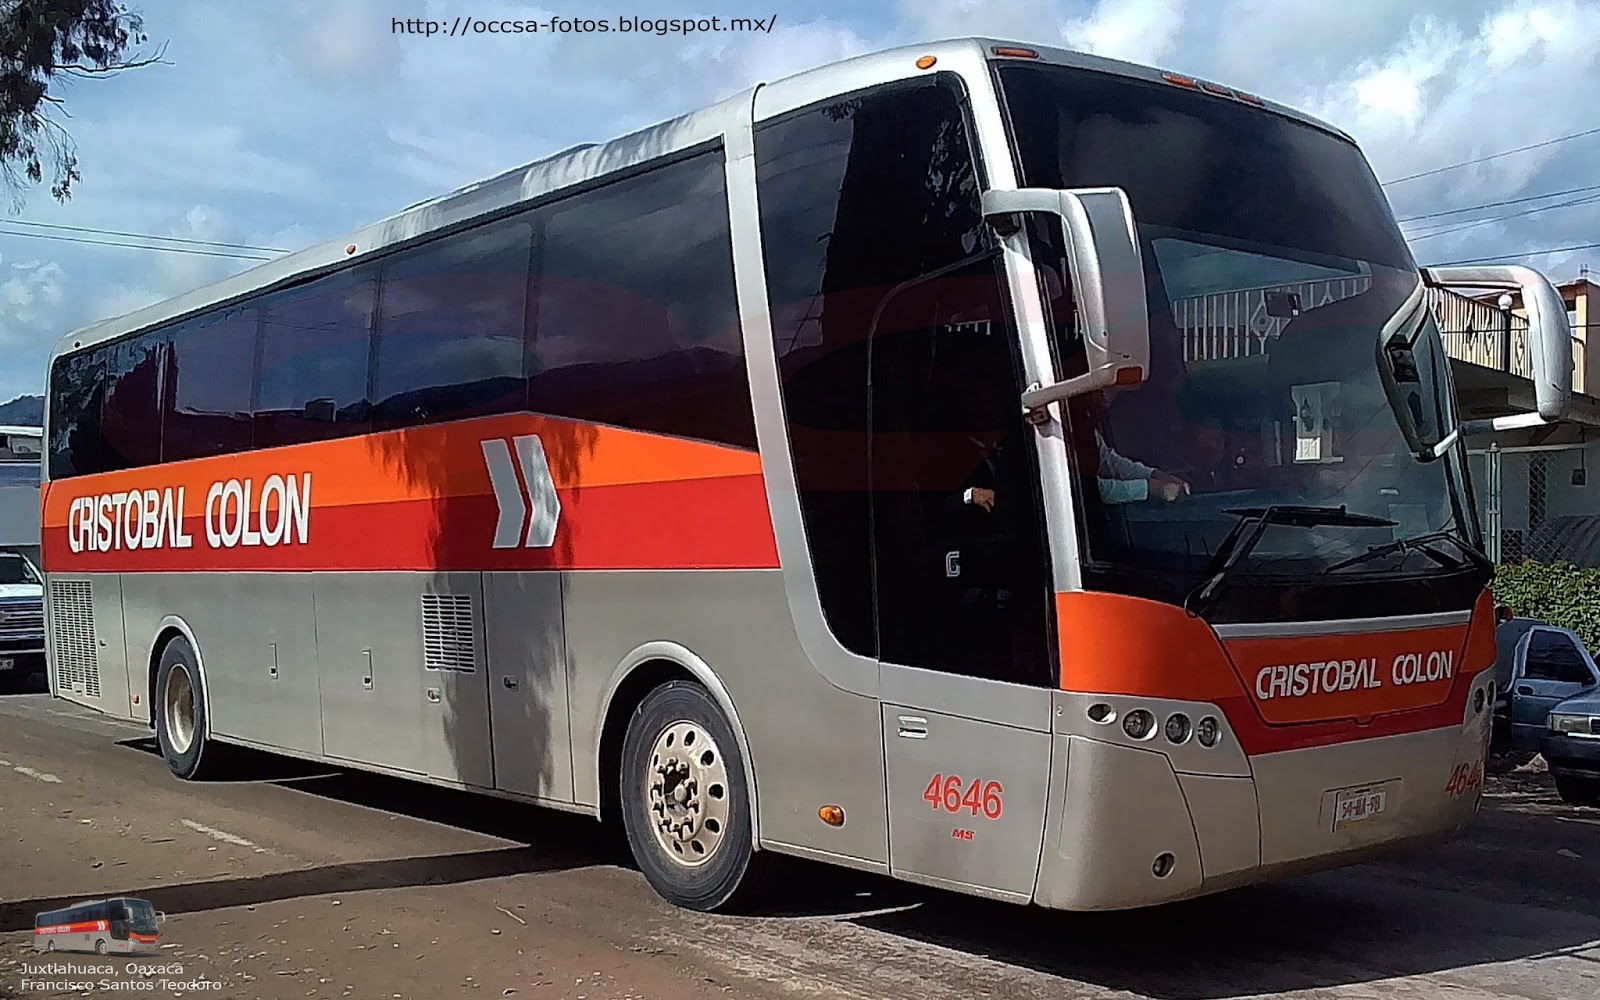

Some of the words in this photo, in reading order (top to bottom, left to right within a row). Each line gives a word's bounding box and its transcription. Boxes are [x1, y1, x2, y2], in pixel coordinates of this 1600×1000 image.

[68, 486, 193, 553] CRISTOBAL
[205, 472, 312, 548] COLON
[1256, 658, 1382, 699] CRISTOBAL
[1392, 650, 1453, 685] COLON
[923, 773, 1004, 820] 4646
[952, 828, 976, 840] MS
